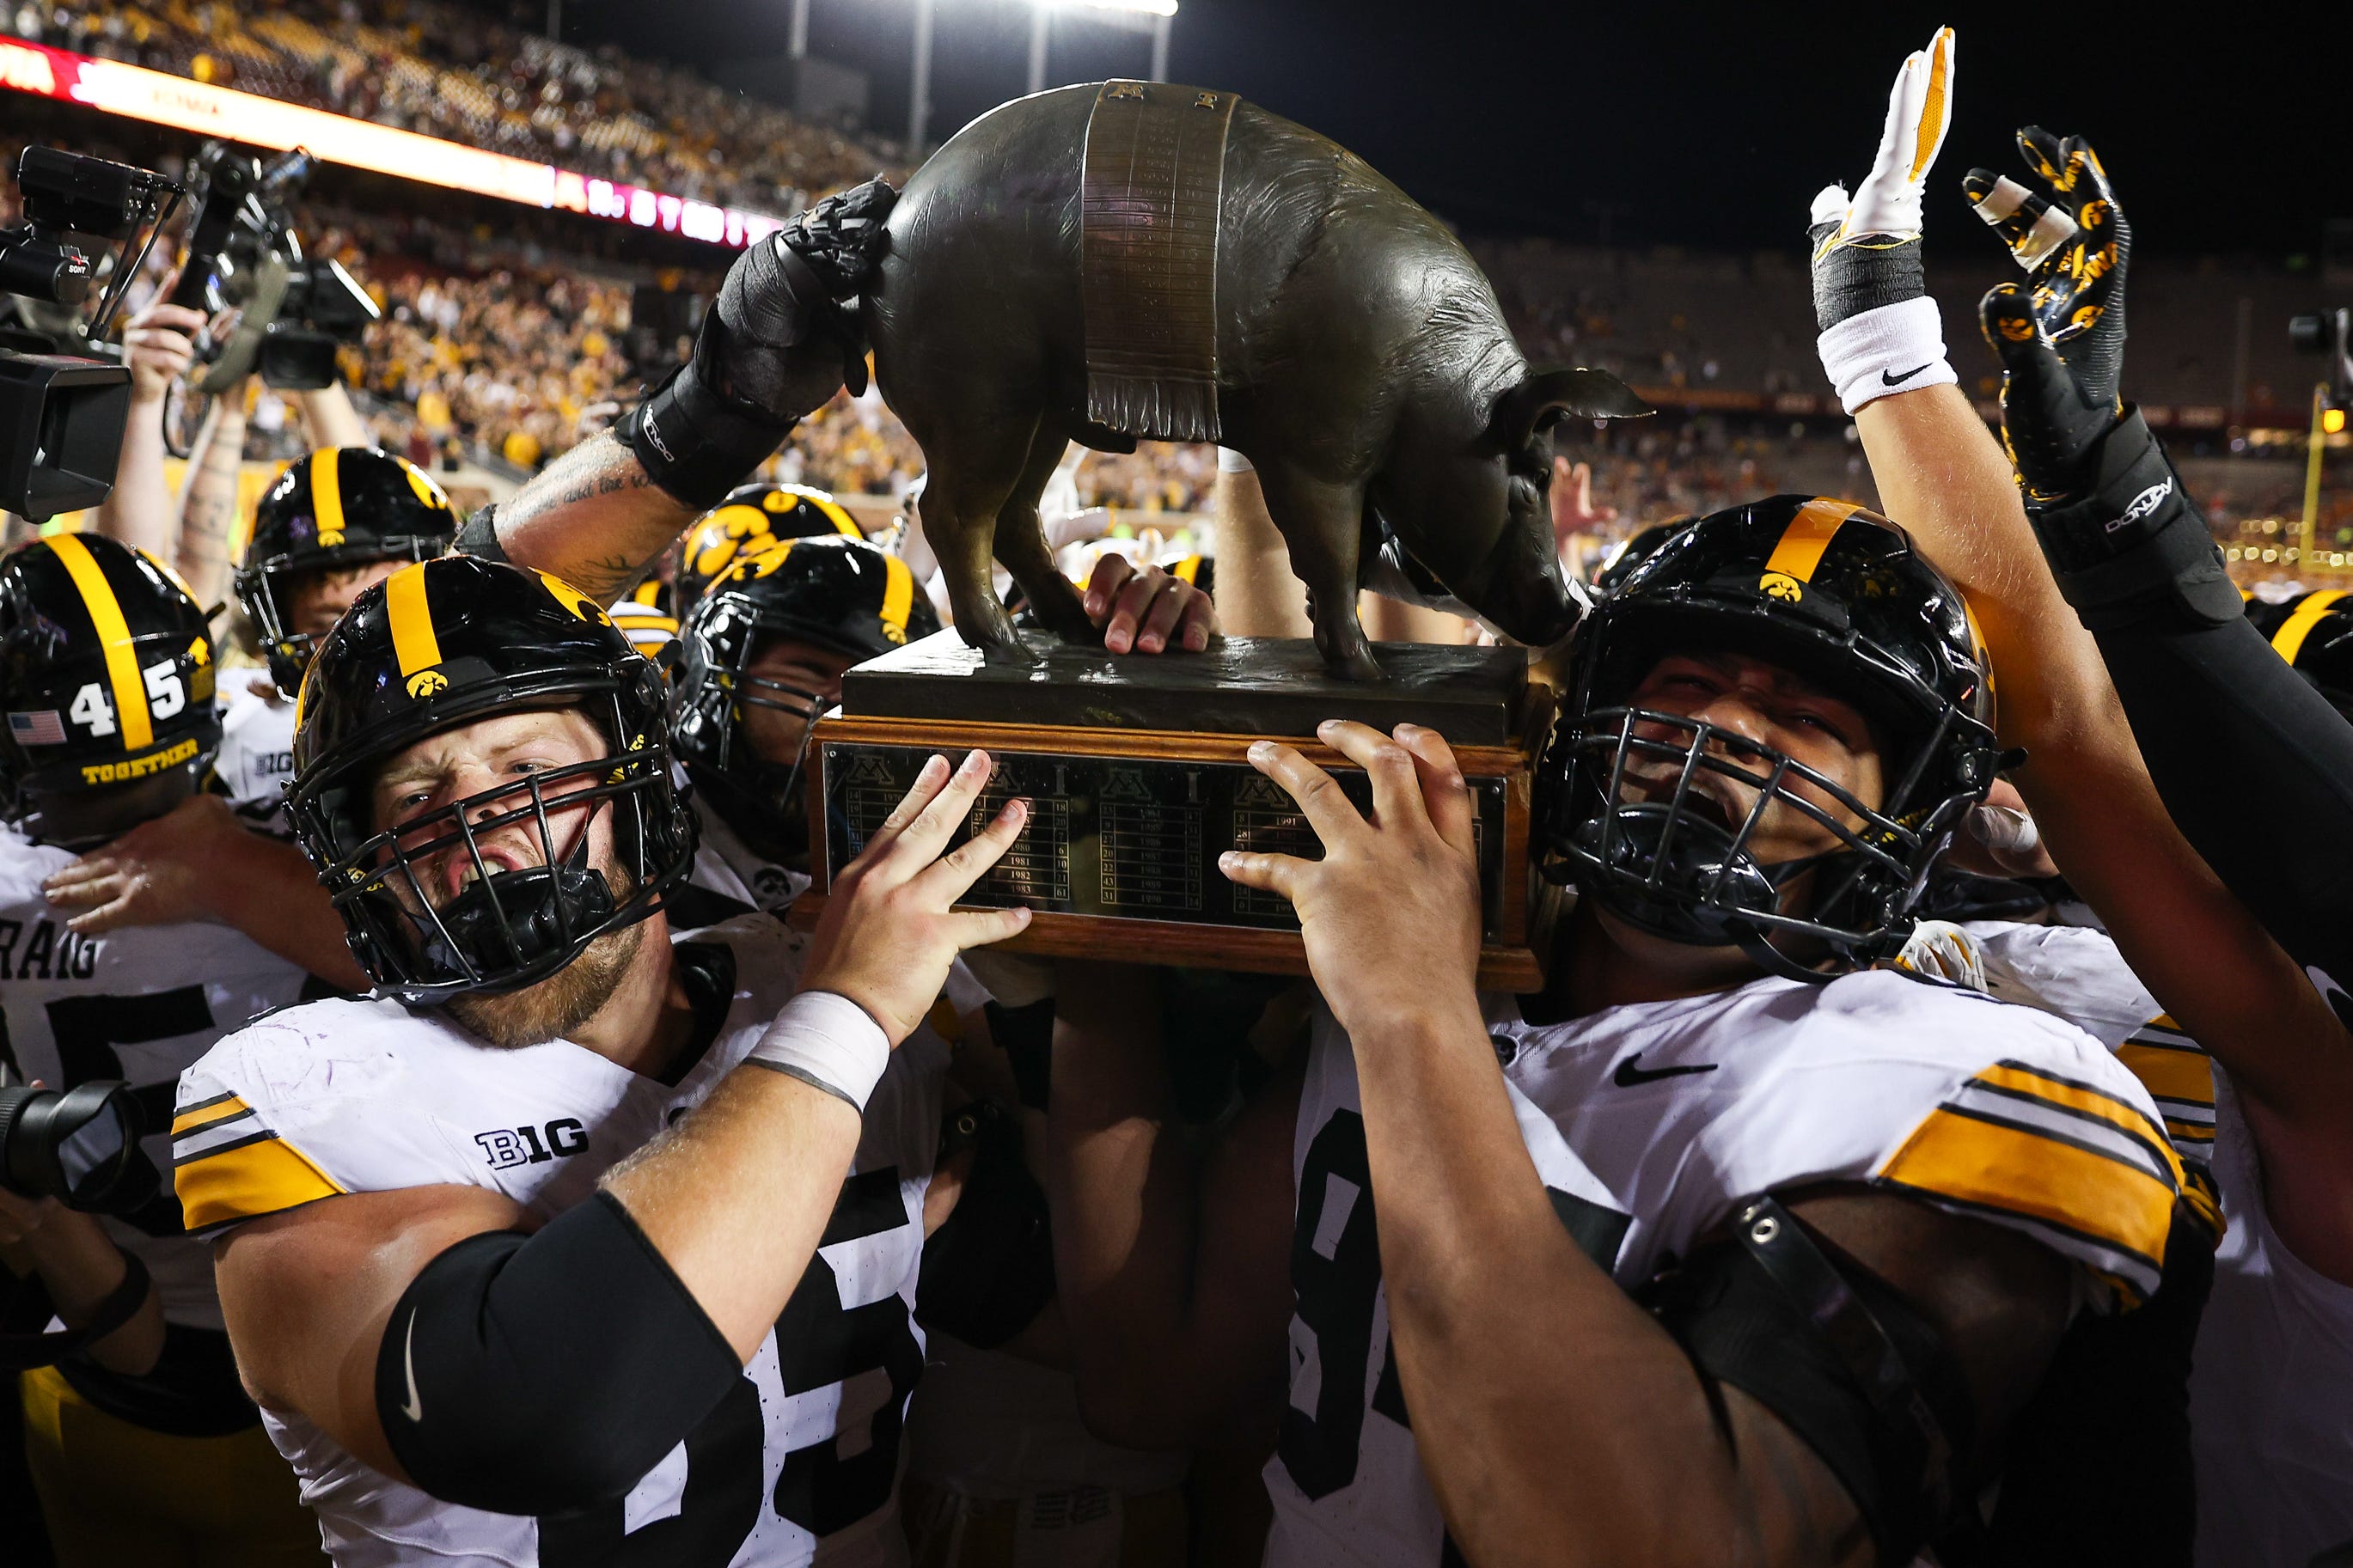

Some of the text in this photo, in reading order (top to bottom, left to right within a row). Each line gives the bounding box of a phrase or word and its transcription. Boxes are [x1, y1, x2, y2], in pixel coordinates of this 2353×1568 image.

[69, 265, 86, 274] SONY
[2105, 475, 2173, 533] DONJOY
[81, 738, 199, 785] TOGETHER
[1055, 803, 1066, 812] 18
[1275, 817, 1296, 826] 1991
[1010, 843, 1065, 855] 1980 6
[1010, 857, 1066, 869] 1981 10
[1010, 869, 1031, 880] 1982
[1011, 884, 1031, 894] 1983
[1056, 888, 1066, 898] 61
